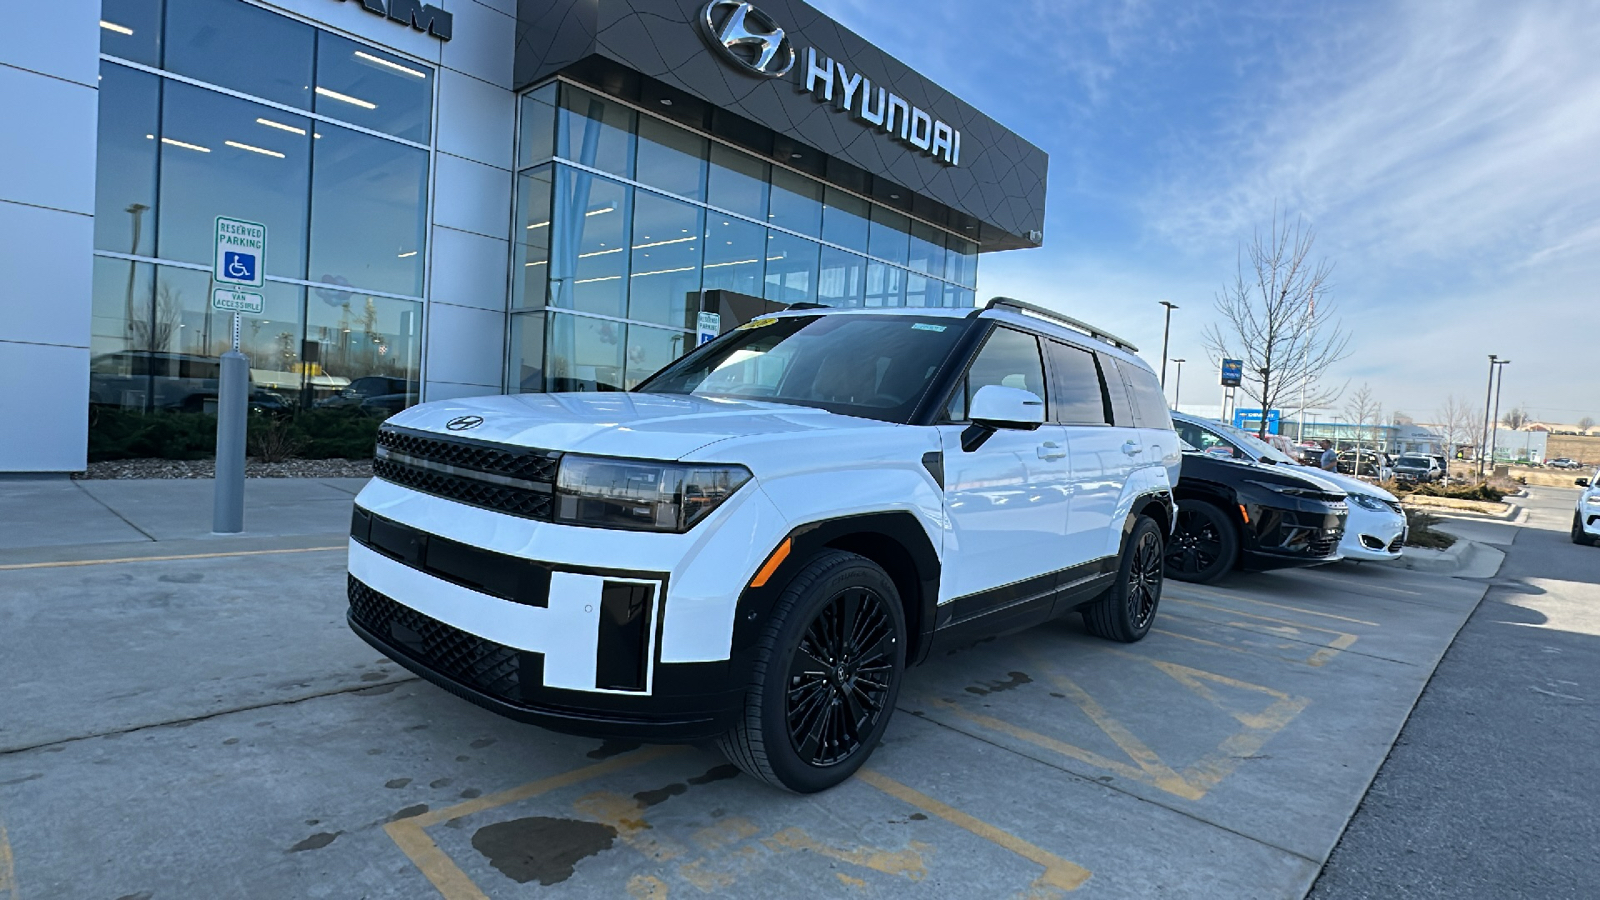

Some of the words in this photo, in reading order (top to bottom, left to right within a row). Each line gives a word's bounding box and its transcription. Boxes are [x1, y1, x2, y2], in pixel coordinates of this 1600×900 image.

[801, 46, 961, 167] HYUNDAI
[220, 222, 262, 239] RESERVED
[220, 234, 262, 249] PARKING
[216, 299, 260, 310] ACCESSIBLE
[232, 293, 246, 301] VAN
